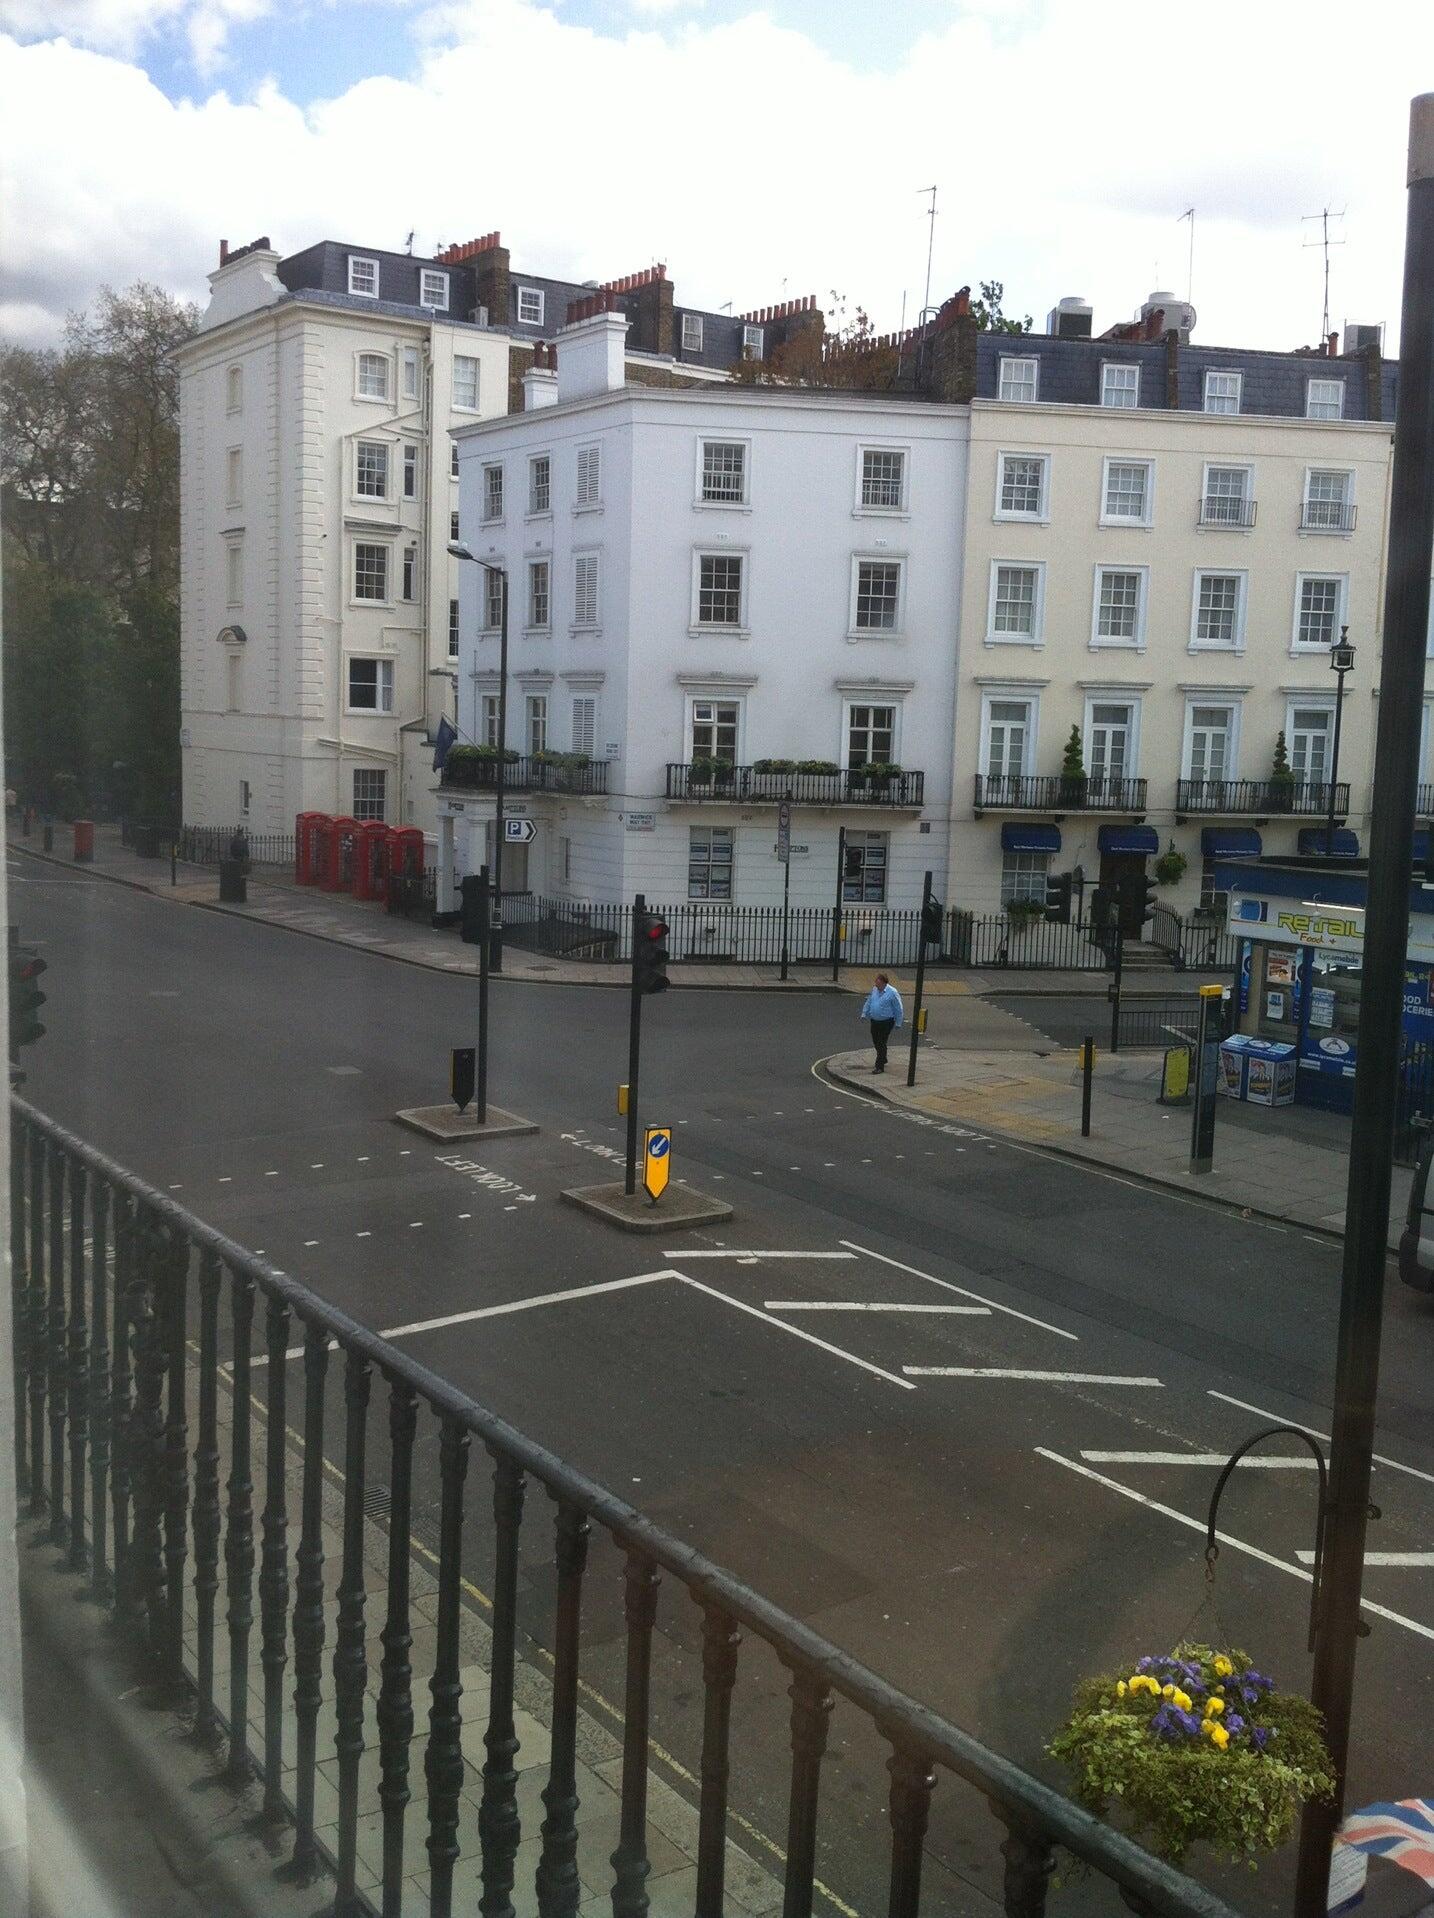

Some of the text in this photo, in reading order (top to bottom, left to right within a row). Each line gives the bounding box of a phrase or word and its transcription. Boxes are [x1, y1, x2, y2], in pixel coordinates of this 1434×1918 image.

[510, 822, 519, 833] P
[1299, 932, 1324, 944] Food
[572, 1140, 624, 1158] LOOK
[434, 1155, 522, 1193] LOOK LEFT
